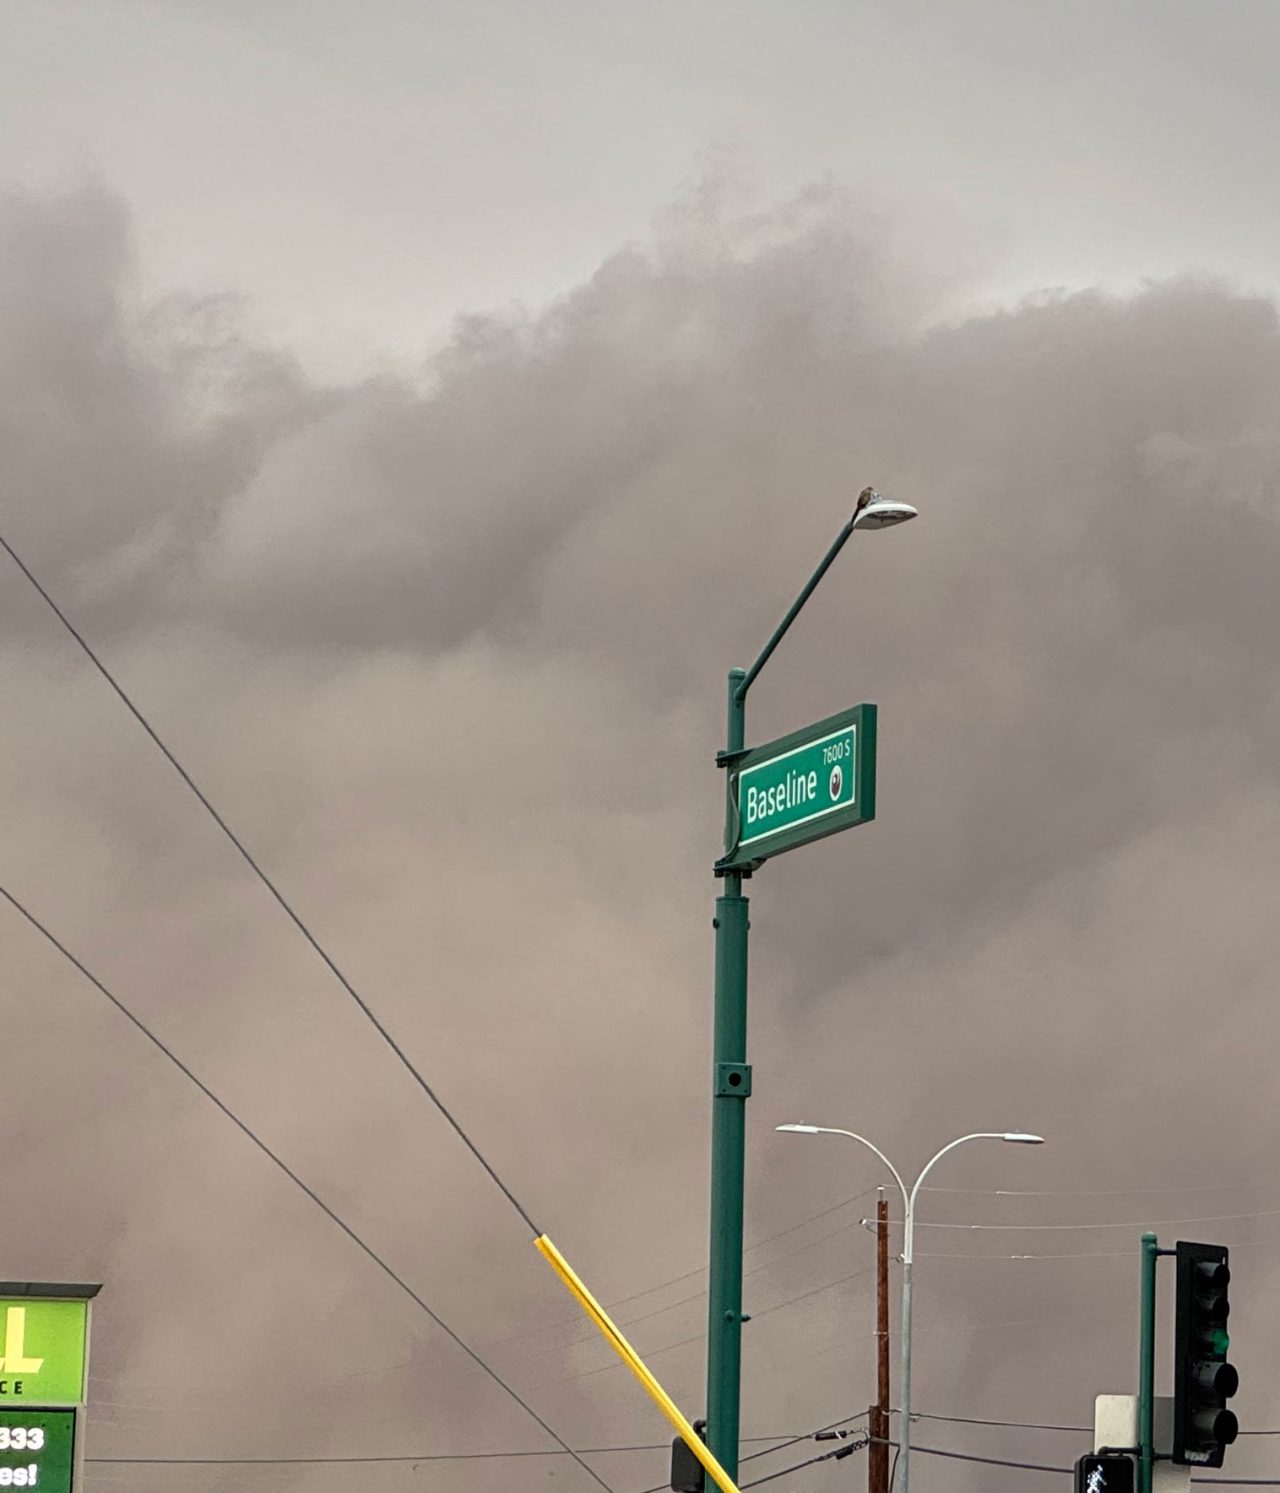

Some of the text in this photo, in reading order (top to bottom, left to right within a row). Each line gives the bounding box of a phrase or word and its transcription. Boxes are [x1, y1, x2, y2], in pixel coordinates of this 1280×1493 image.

[822, 739, 850, 765] 7600 S
[747, 770, 817, 823] Baseline
[0, 1463, 38, 1486] es!
